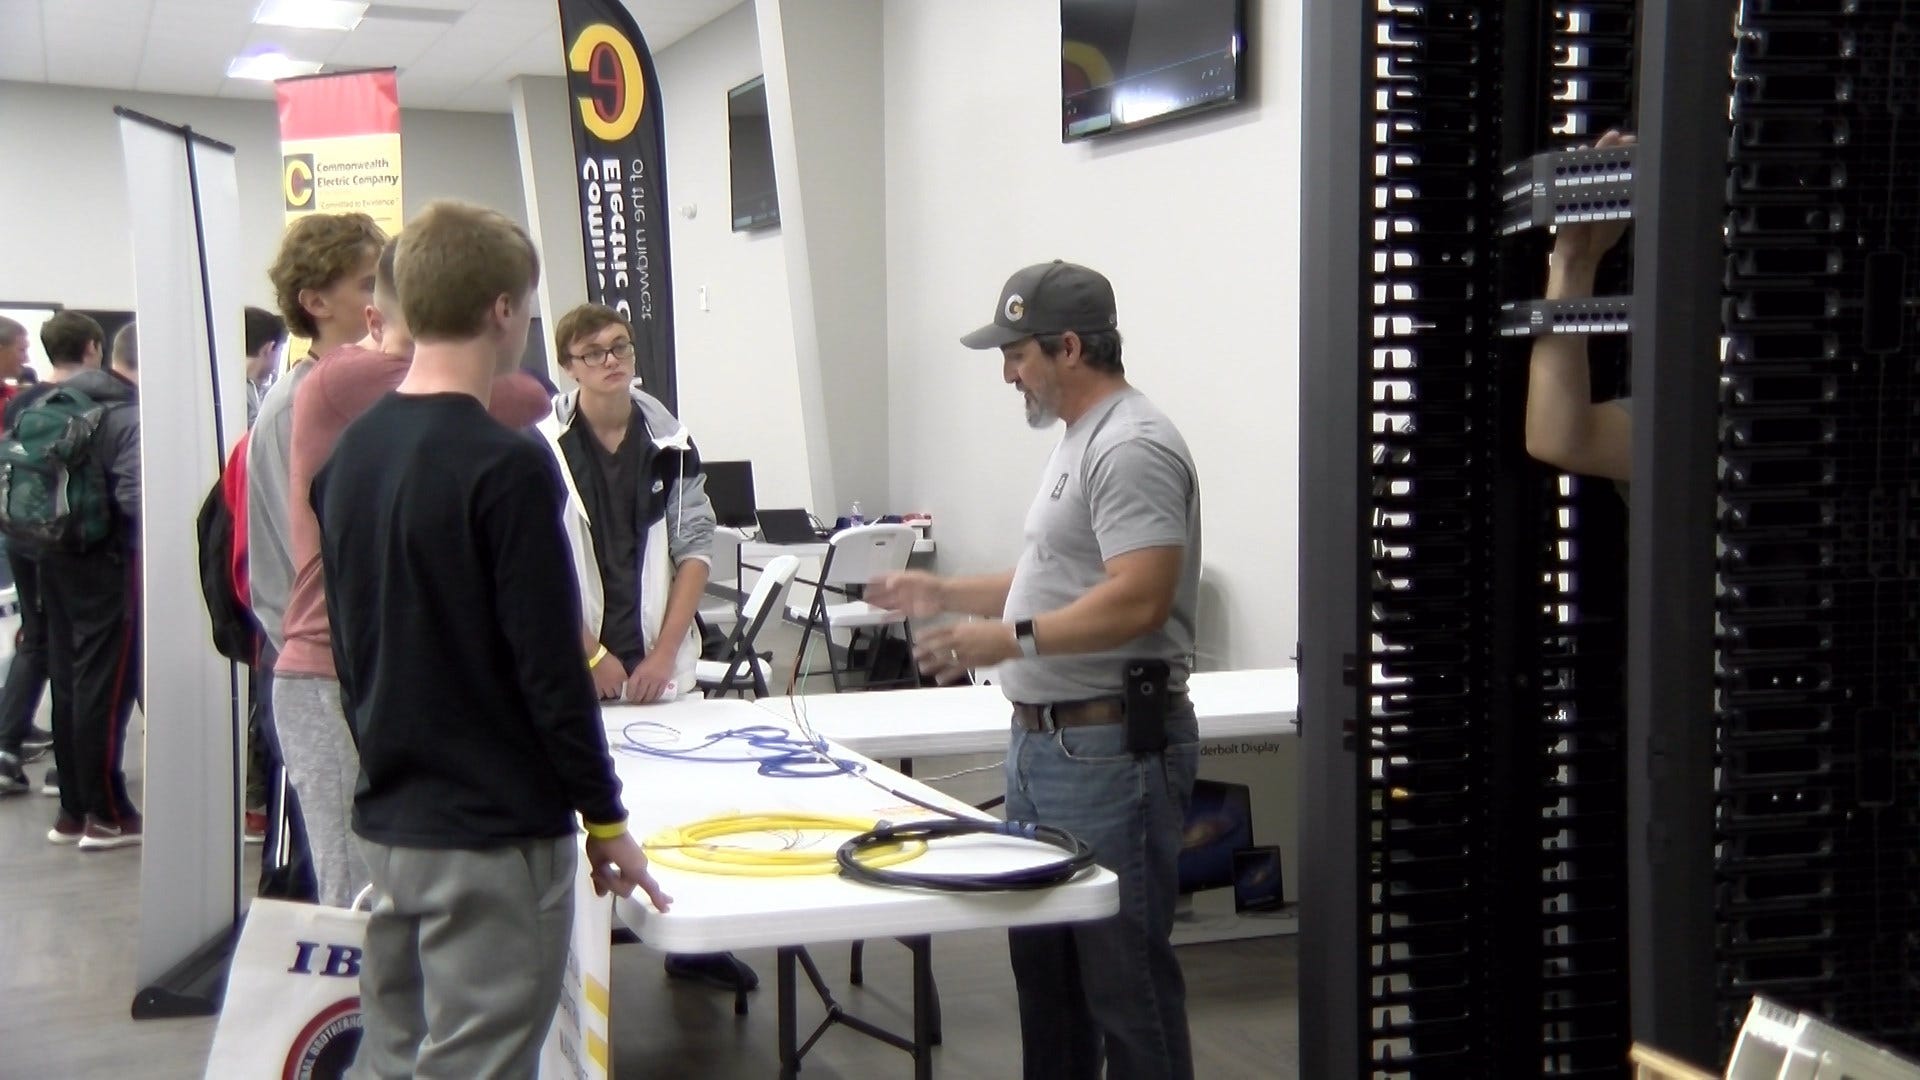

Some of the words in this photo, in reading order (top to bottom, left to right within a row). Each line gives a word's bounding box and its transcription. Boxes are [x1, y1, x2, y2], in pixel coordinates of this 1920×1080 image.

[317, 158, 389, 172] Commonwealth
[317, 176, 350, 188] Electric
[352, 175, 399, 187] Company
[1241, 742, 1279, 755] Display
